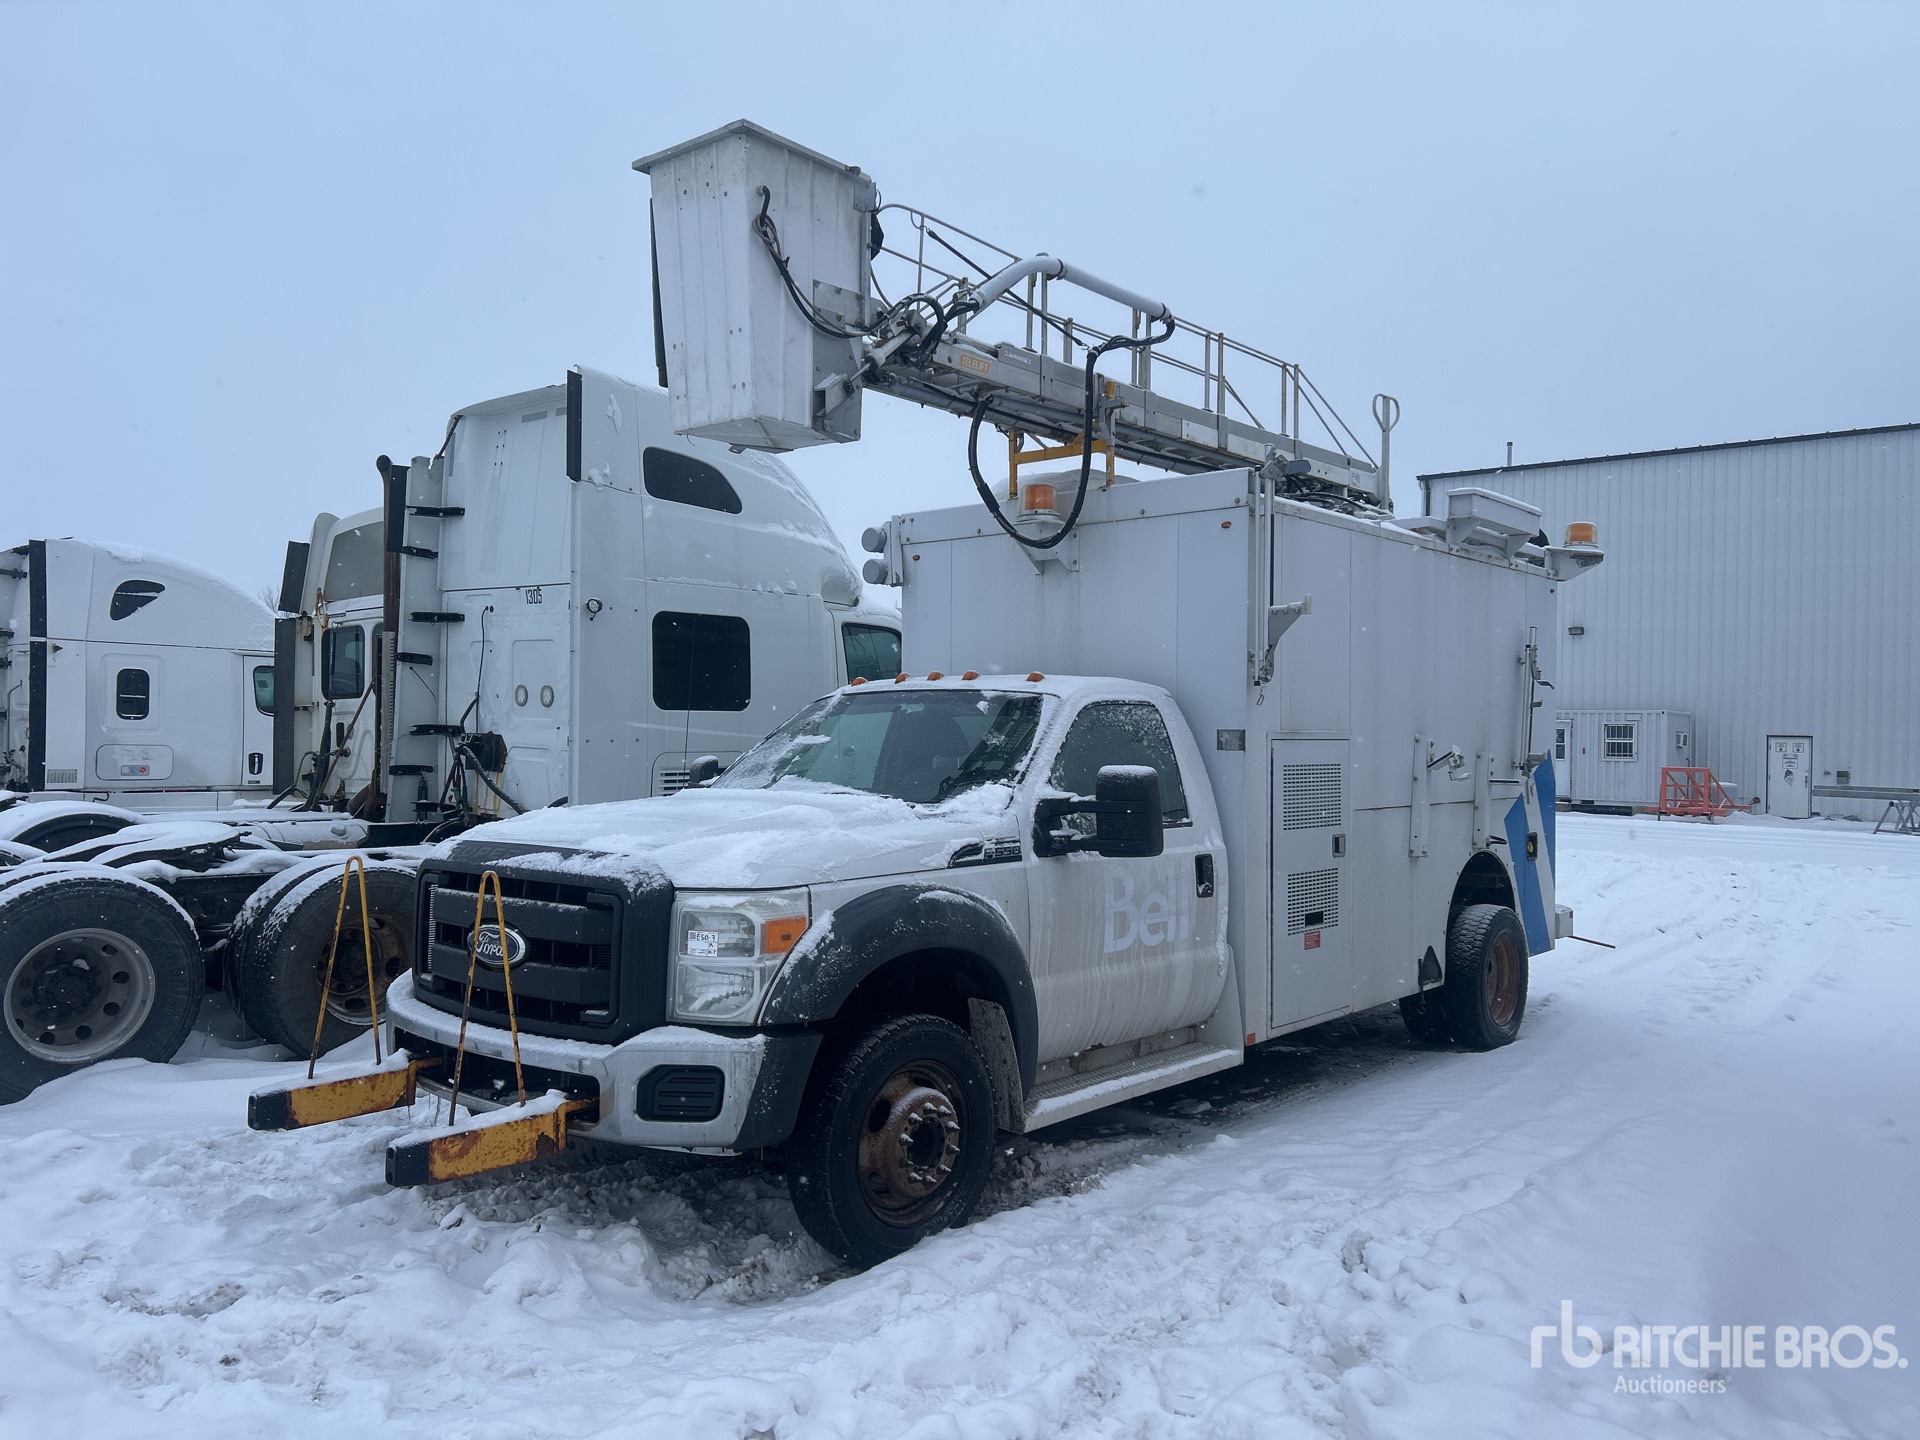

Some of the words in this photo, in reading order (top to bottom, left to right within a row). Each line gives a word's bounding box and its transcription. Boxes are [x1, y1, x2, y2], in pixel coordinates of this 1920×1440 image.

[961, 355, 989, 372] TELELIFT
[525, 588, 543, 605] 1305
[1103, 864, 1189, 954] Bell
